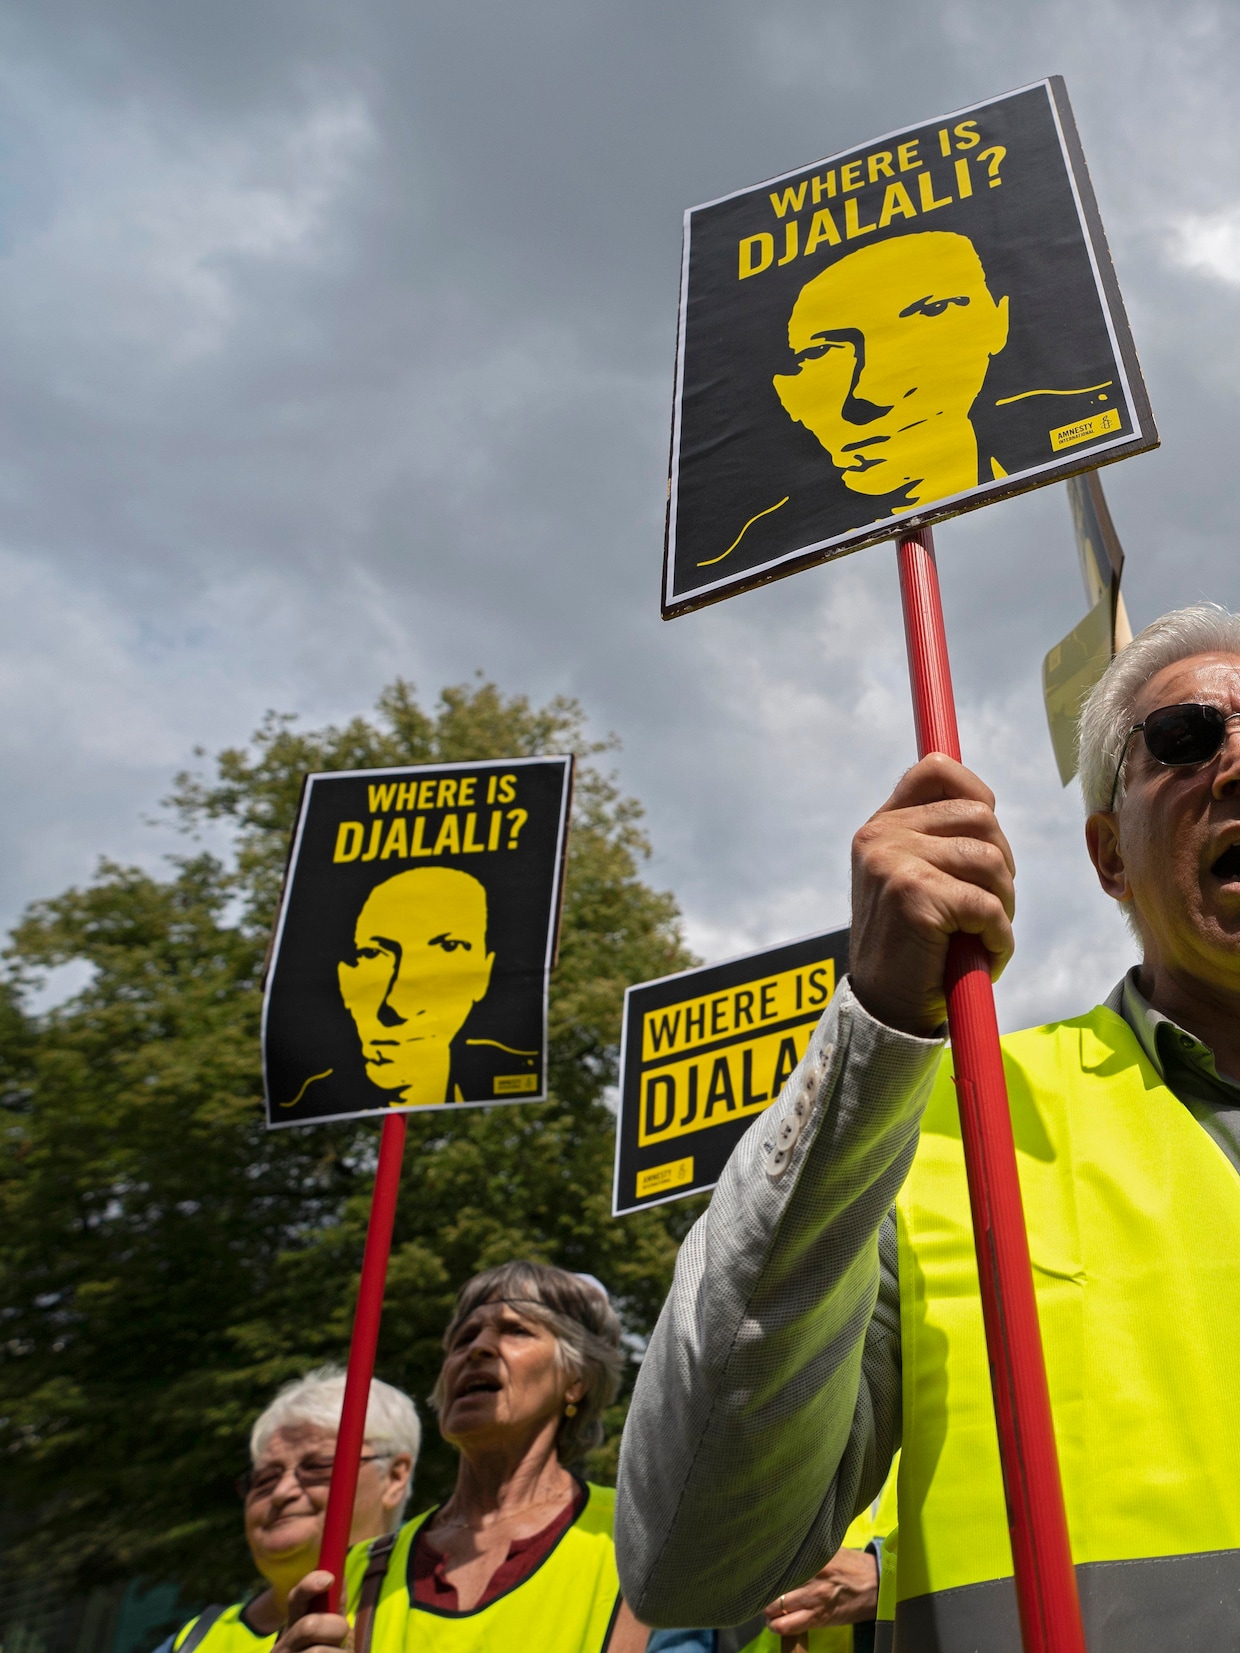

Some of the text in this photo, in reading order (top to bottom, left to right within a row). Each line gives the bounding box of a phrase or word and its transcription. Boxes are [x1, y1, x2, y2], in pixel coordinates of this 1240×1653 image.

[769, 119, 982, 219] WHERE IS
[738, 145, 1007, 281] DJALALI?
[1057, 421, 1093, 440] AMNESTY
[1058, 429, 1095, 445] INTERNATIONAL
[366, 773, 518, 814] WHERE IS
[332, 808, 529, 865] DJALALI?
[648, 967, 829, 1054] WHERE IS
[645, 1031, 814, 1137] DJALA
